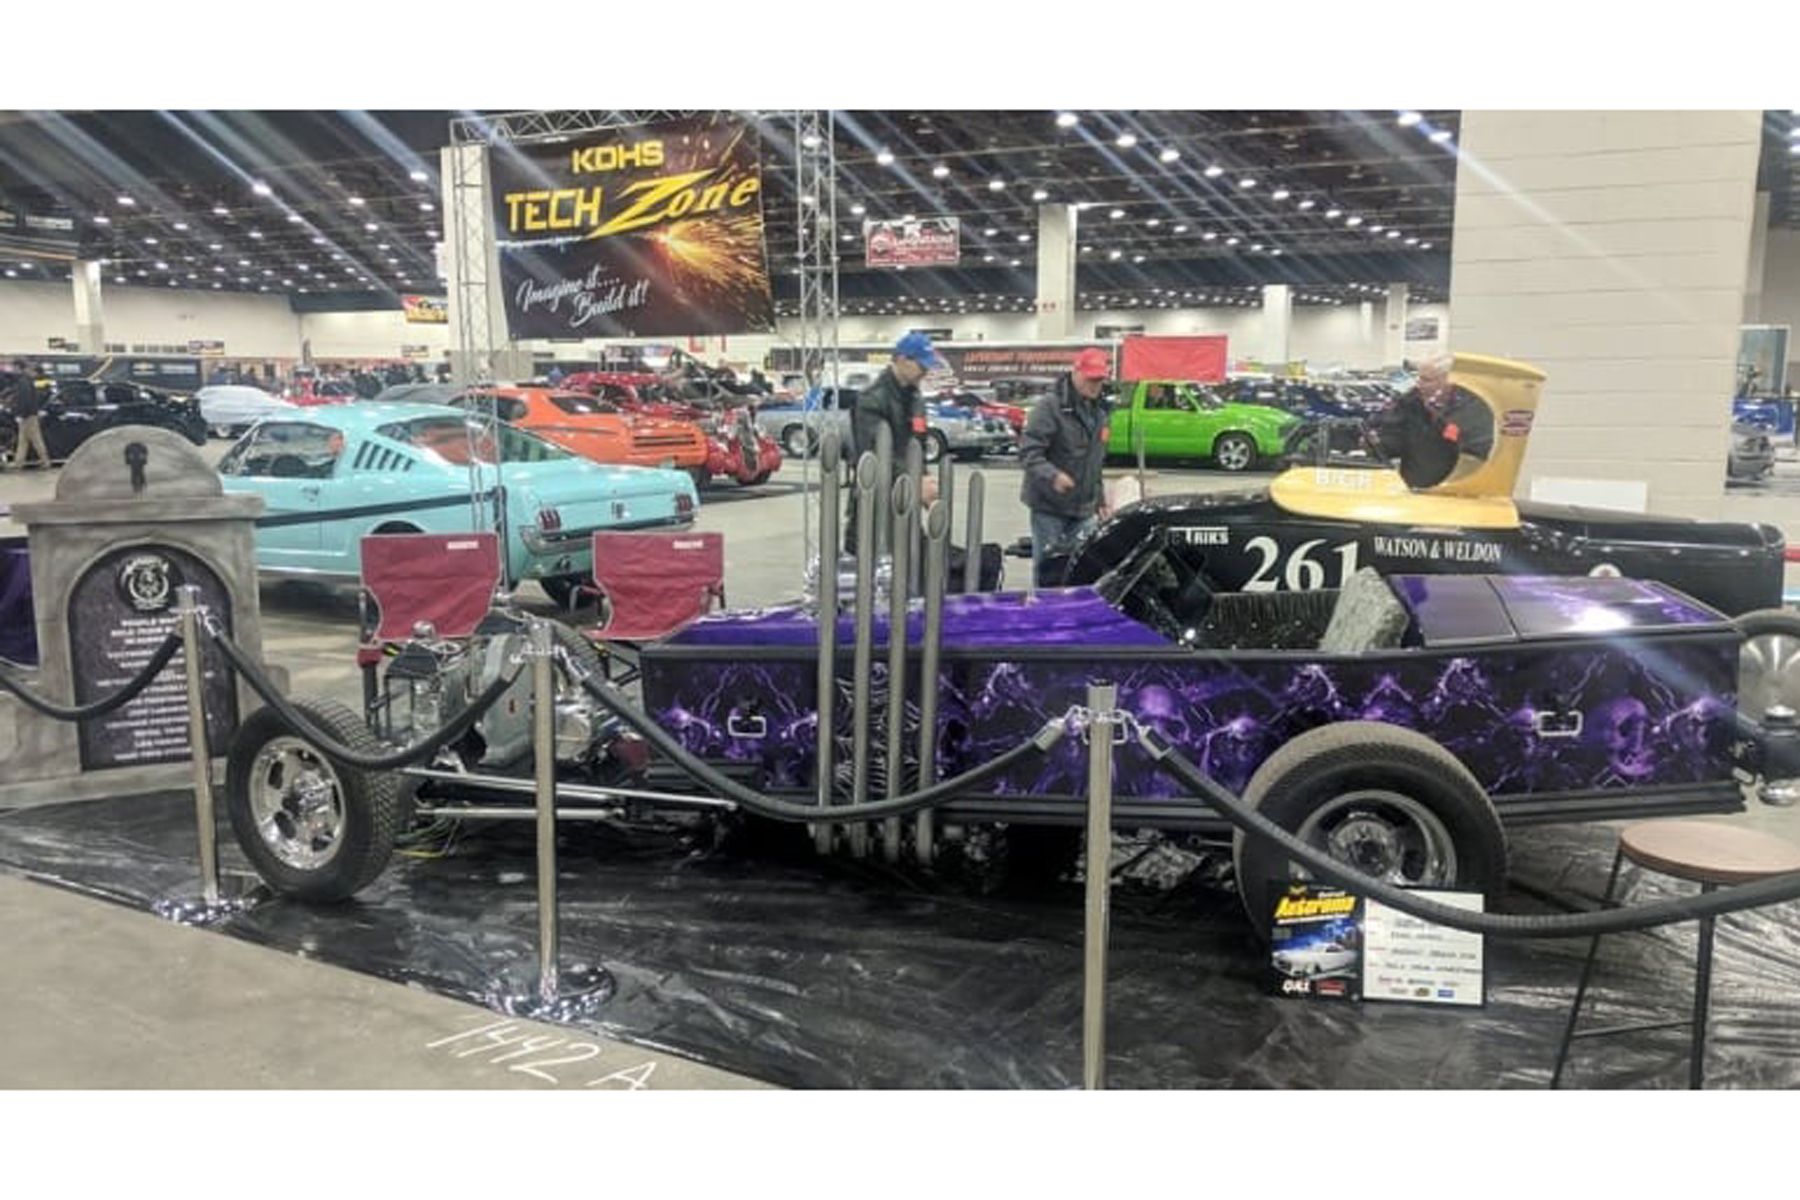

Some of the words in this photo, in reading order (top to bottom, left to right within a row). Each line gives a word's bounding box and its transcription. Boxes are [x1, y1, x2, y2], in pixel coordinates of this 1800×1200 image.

[504, 187, 602, 232] TECH
[586, 167, 761, 240] Zone
[515, 278, 583, 312] Imagine
[569, 284, 626, 328] Build
[627, 279, 650, 307] it!
[1241, 535, 1358, 592] 261
[1374, 536, 1429, 558] WATSON
[1429, 540, 1441, 559] &
[1443, 540, 1502, 563] WELDON
[584, 1060, 658, 1090] A
